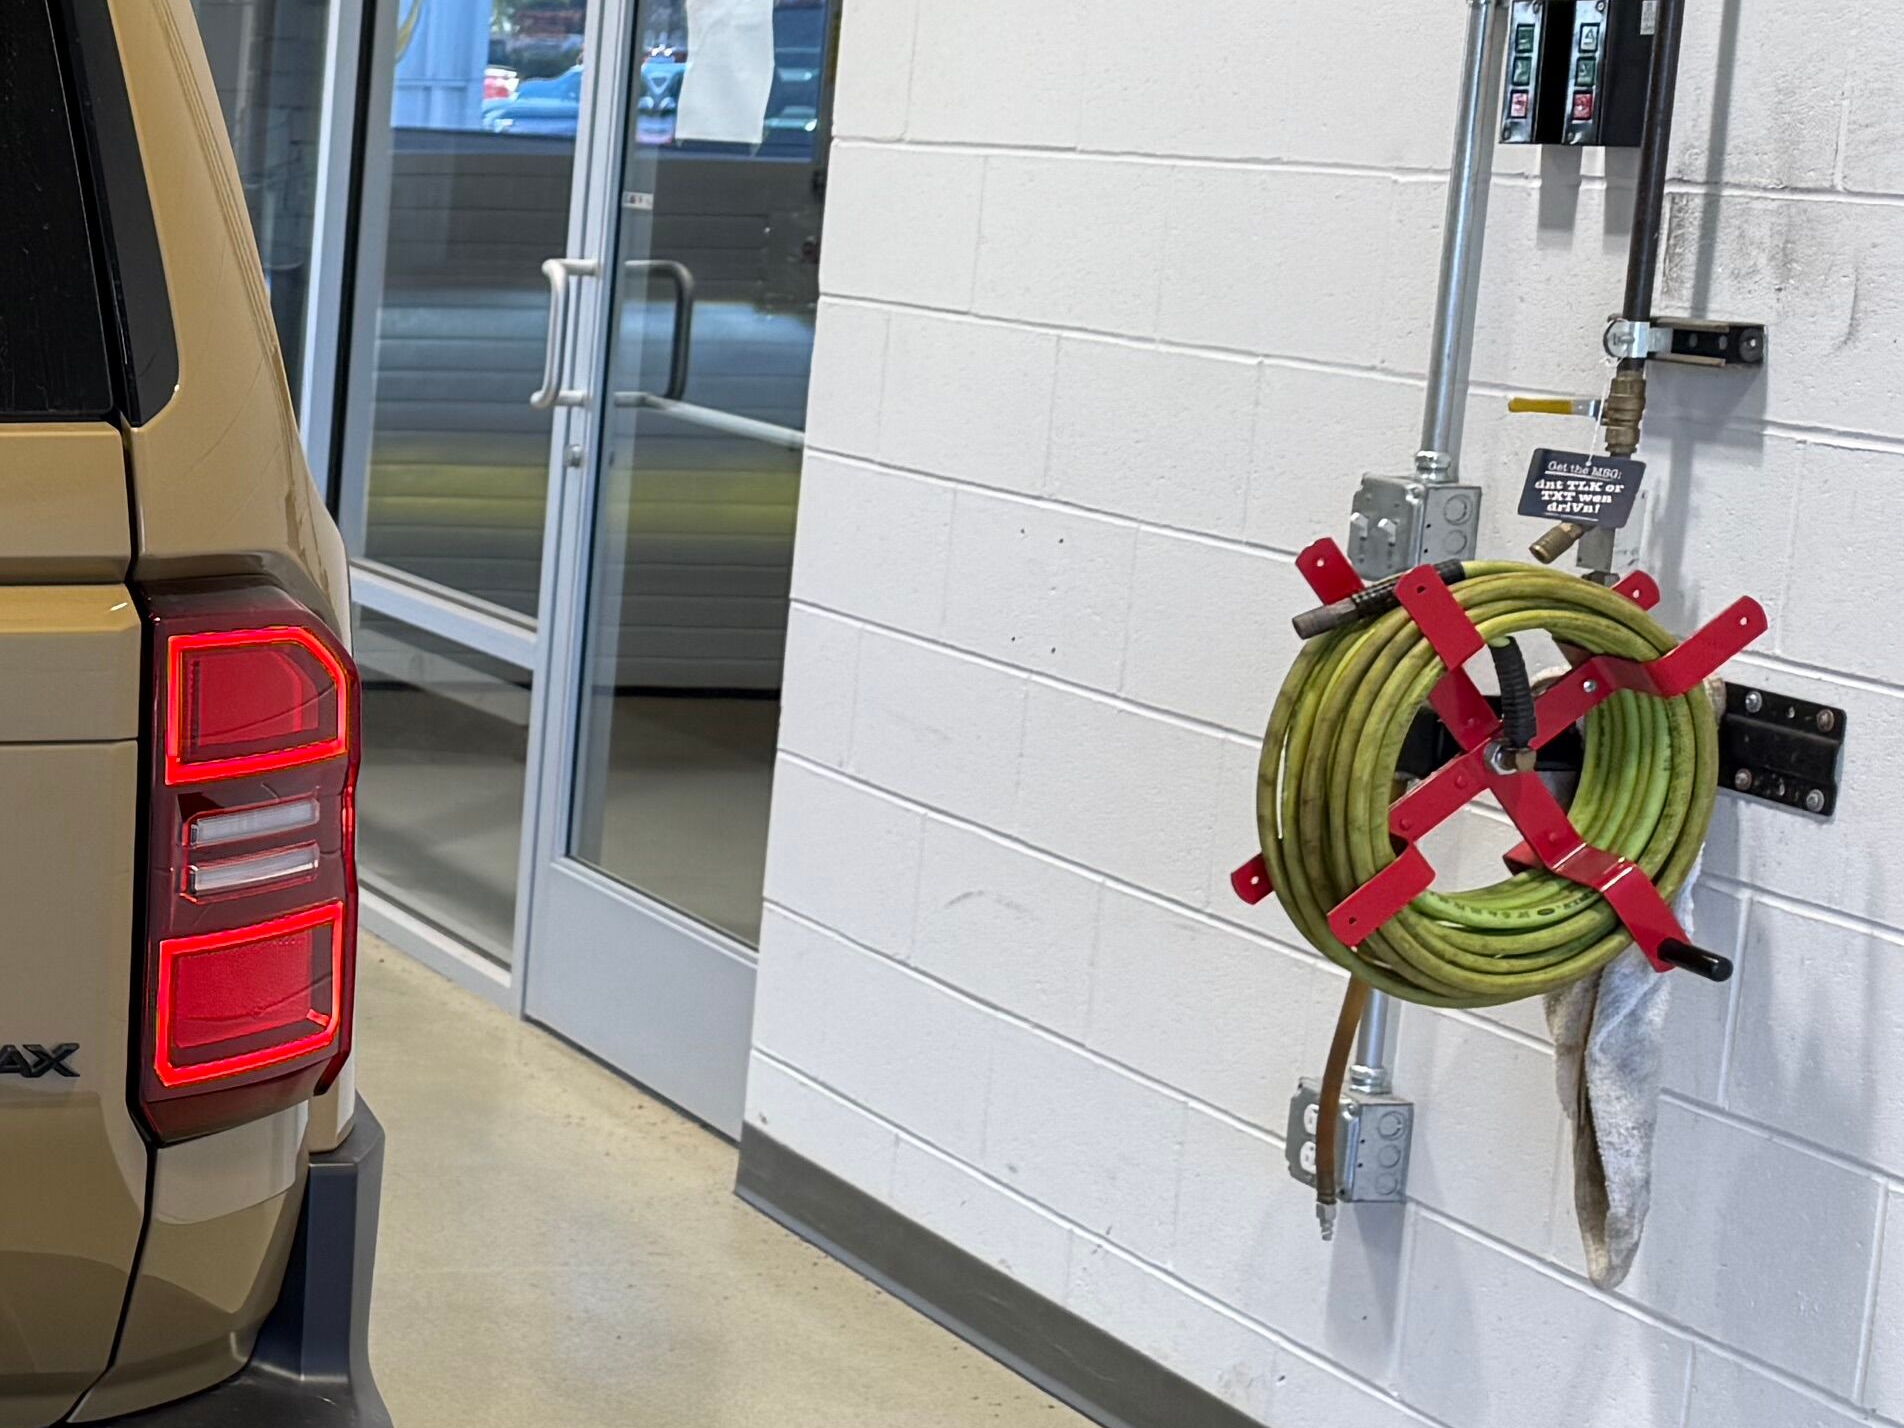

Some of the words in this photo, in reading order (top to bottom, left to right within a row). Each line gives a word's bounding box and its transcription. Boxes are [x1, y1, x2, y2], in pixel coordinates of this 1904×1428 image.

[1547, 460, 1568, 472] Get
[1571, 464, 1589, 476] the
[1534, 479, 1563, 490] dnt
[1566, 480, 1603, 492] TLK
[1605, 483, 1624, 493] or
[1541, 490, 1575, 501] TXT
[1578, 494, 1612, 504] wen
